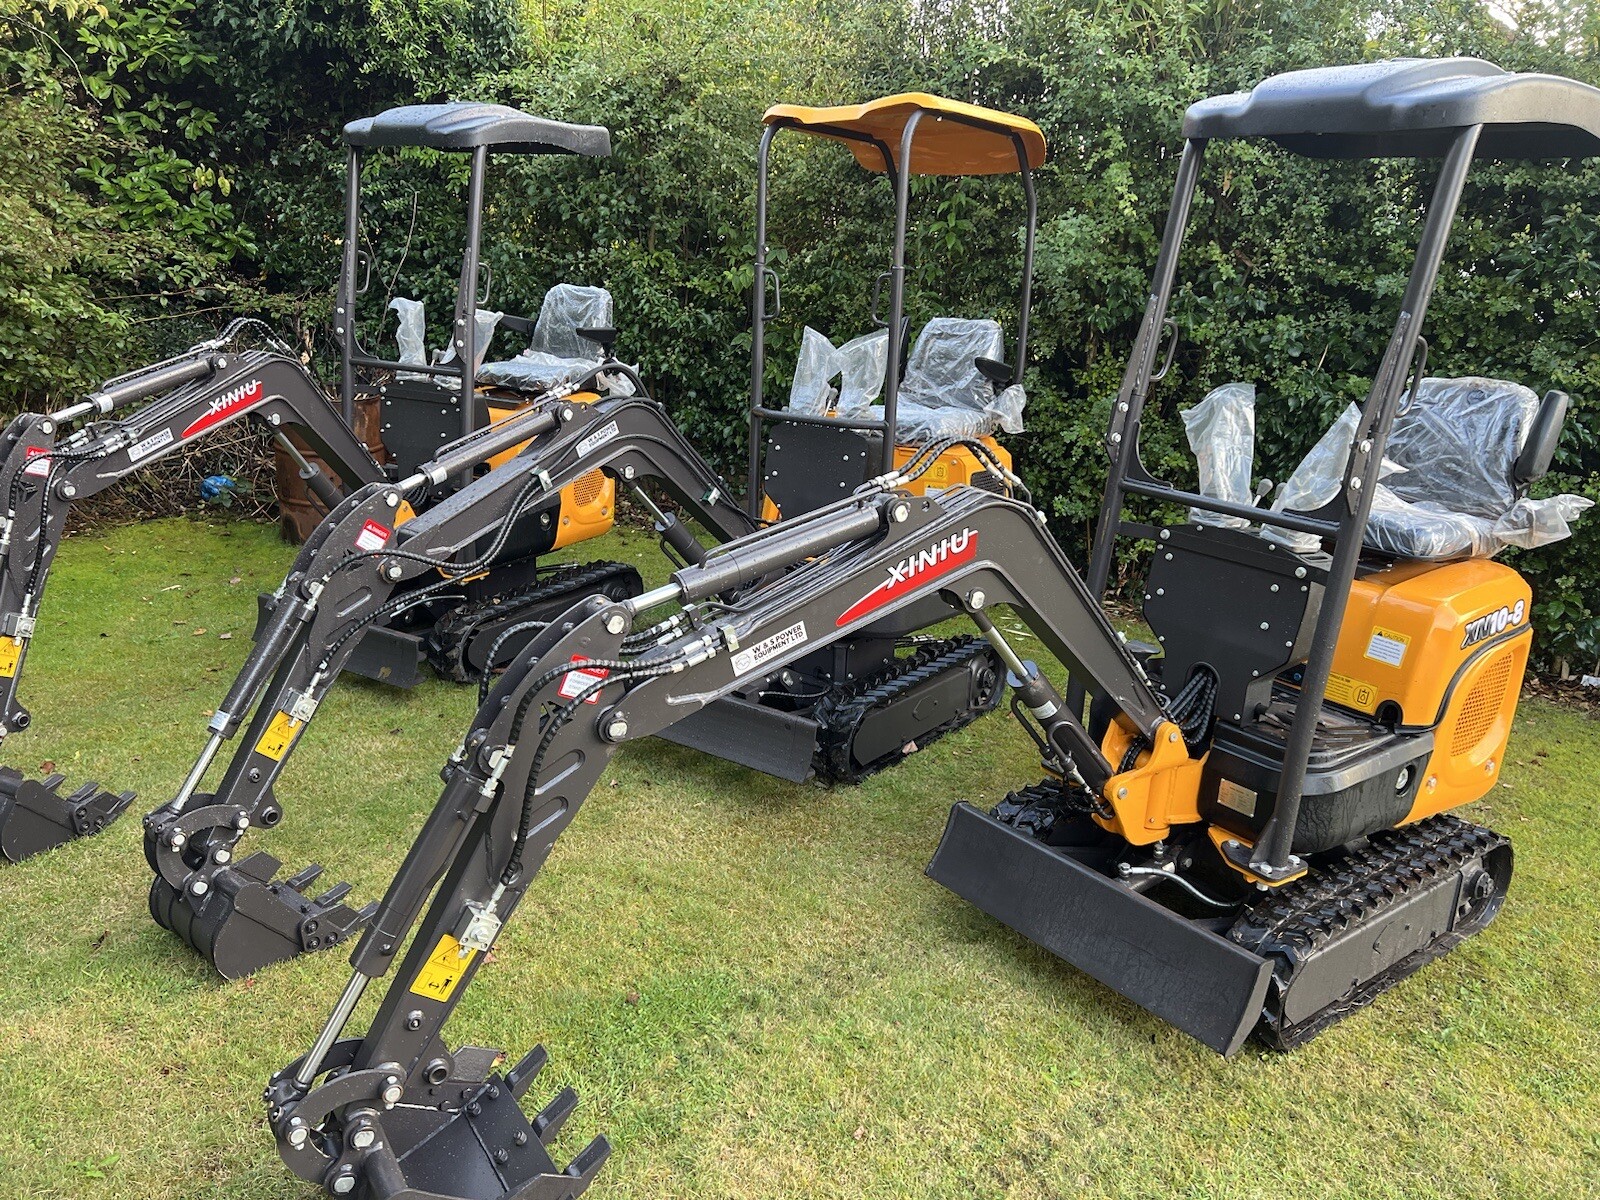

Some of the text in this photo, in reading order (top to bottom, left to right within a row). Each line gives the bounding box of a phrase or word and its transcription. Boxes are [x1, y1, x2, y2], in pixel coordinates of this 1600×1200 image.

[208, 379, 257, 416] XINIU
[885, 527, 970, 590] XINIU
[752, 644, 761, 654] W
[762, 642, 769, 650] &
[775, 624, 802, 643] POWER
[1460, 599, 1525, 650] XN10-8
[753, 638, 790, 661] EQUIPMENT
[791, 631, 804, 641] LTD
